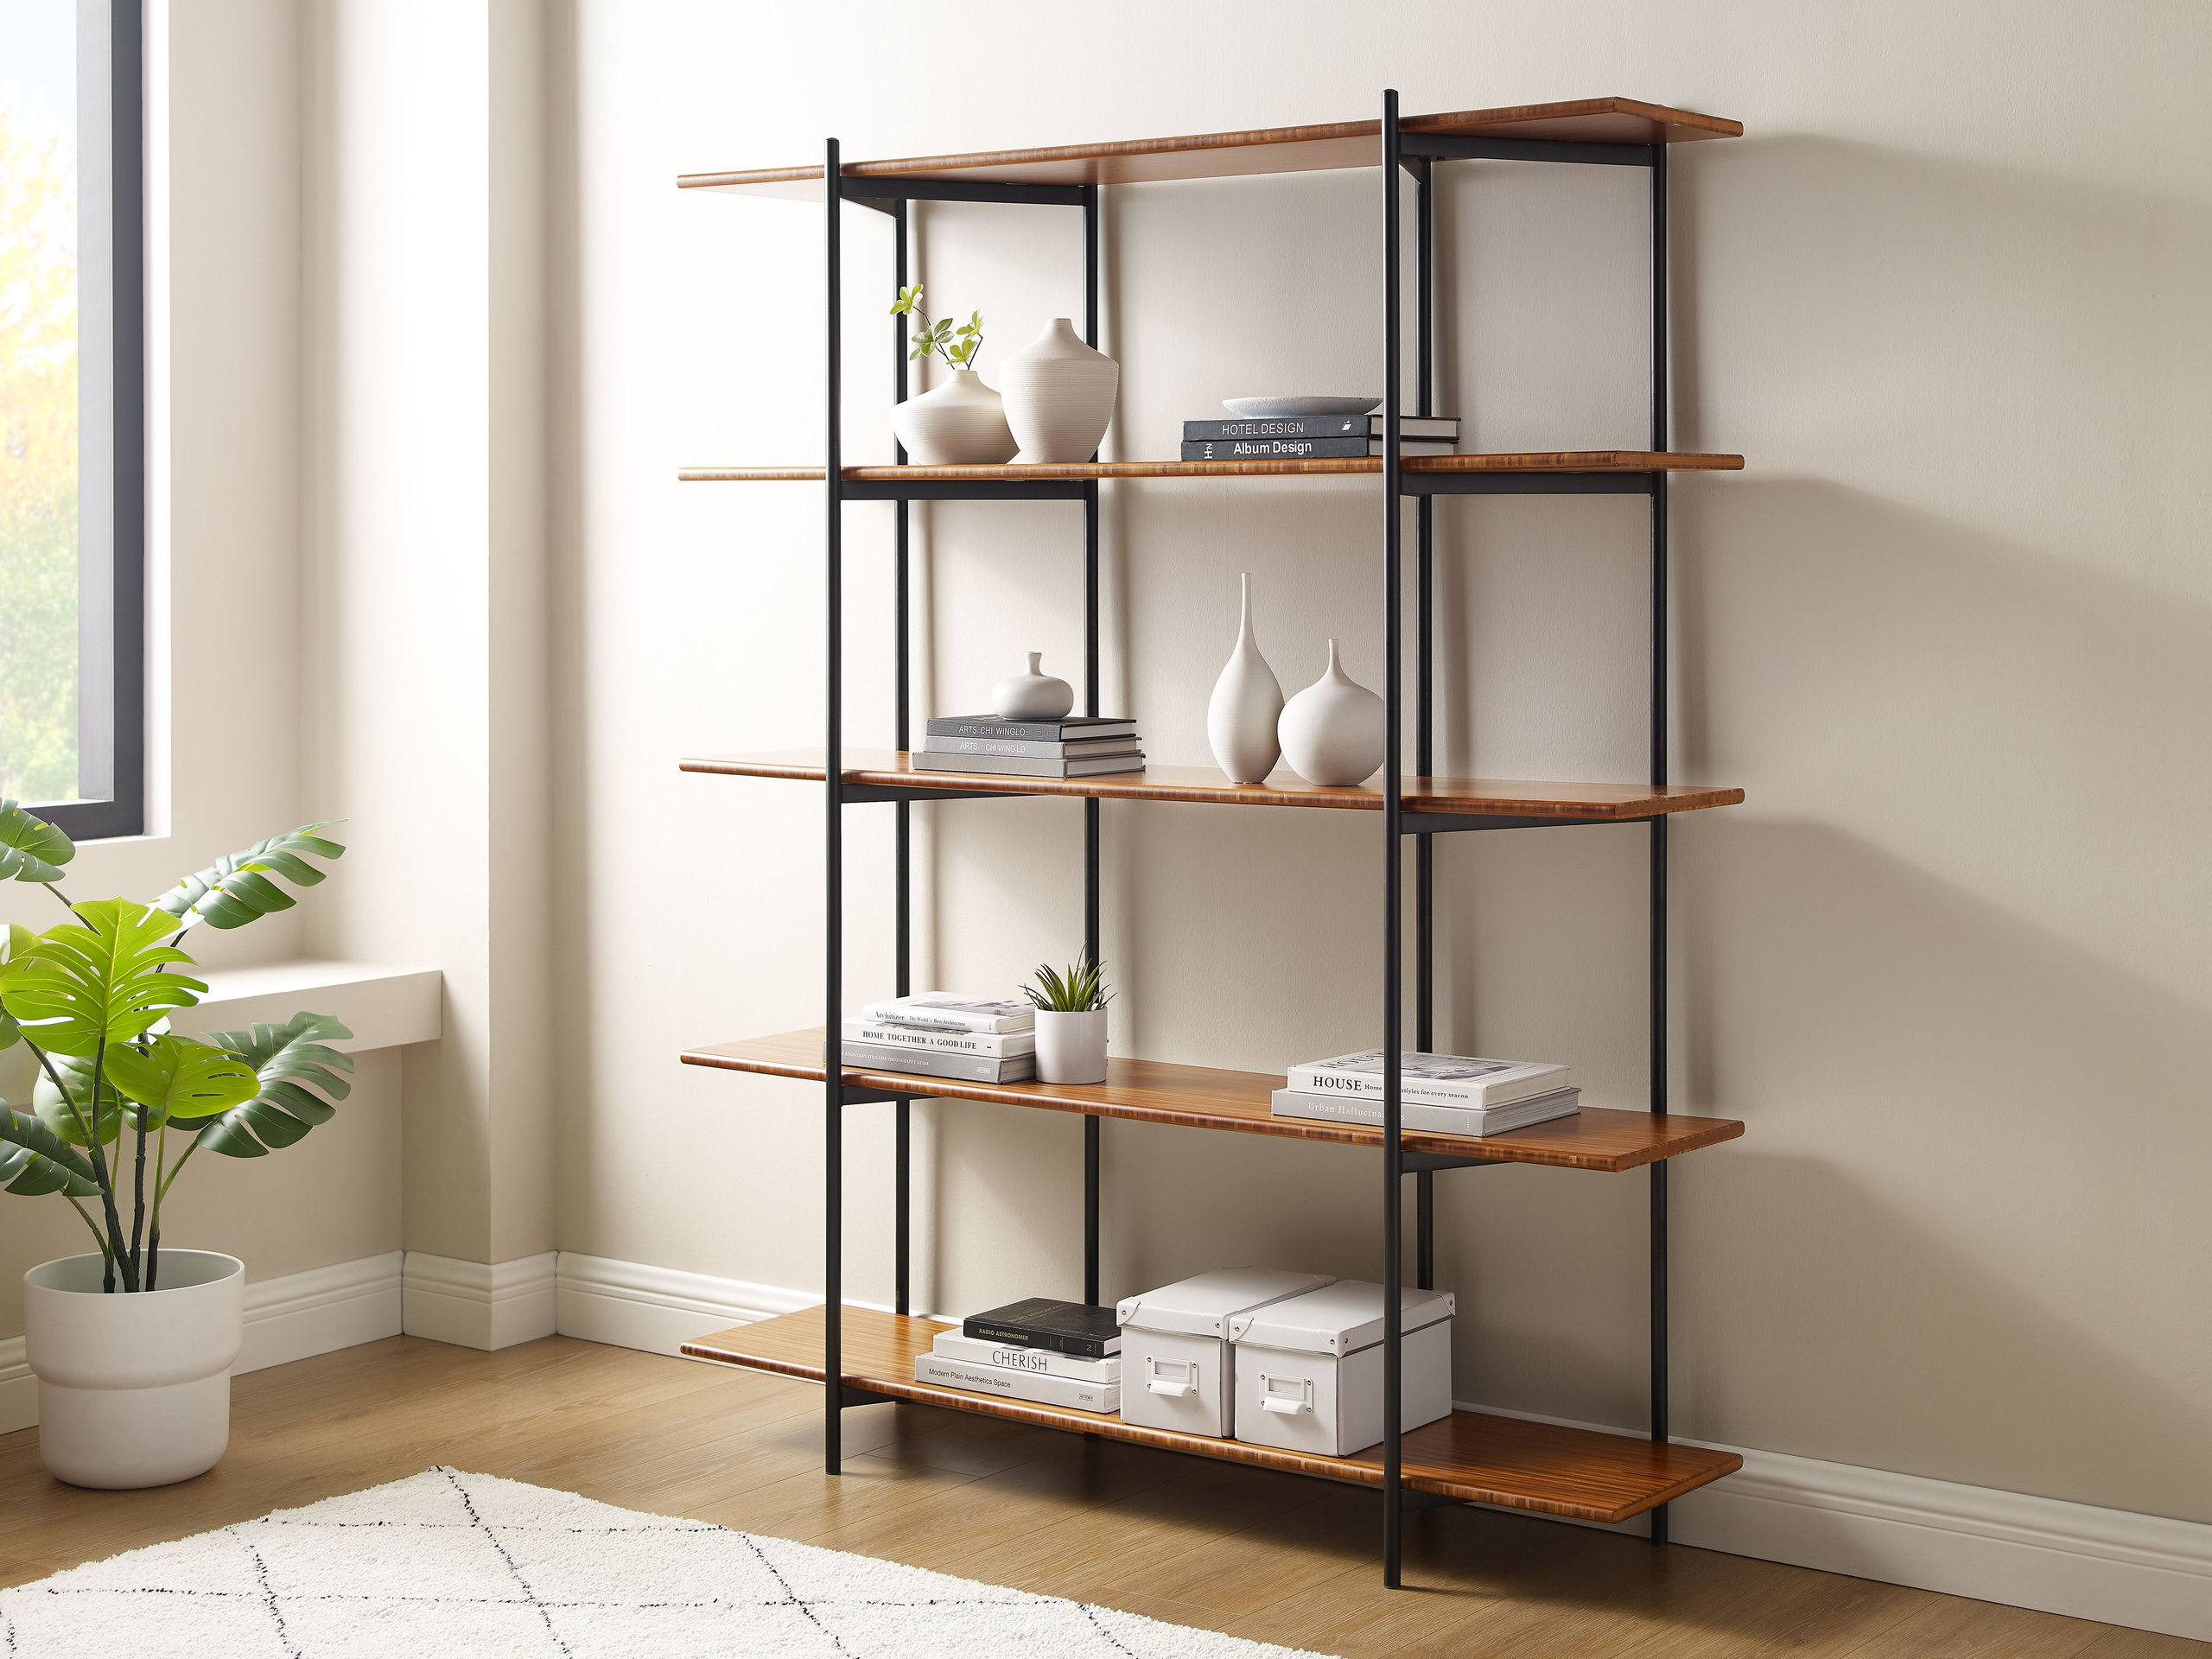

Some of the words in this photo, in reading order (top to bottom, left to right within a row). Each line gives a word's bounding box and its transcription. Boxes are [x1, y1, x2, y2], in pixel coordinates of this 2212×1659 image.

[1222, 423, 1259, 435] HOTEL
[1261, 423, 1304, 434] DESIGN
[1233, 442, 1270, 454] Album
[1272, 441, 1312, 455] Design
[980, 726, 993, 734] CHI
[862, 1031, 885, 1039] HOME
[887, 1033, 926, 1044] TOGETHER
[937, 1039, 959, 1047] GOOD
[960, 1041, 977, 1050] LIFE
[1313, 1076, 1362, 1090] HOUSE
[1308, 1103, 1335, 1113] Urban
[995, 1332, 1029, 1341] ASTRONOMER
[992, 1351, 1048, 1371] CHERISH
[929, 1368, 950, 1377] Modern
[964, 1375, 993, 1385] Aesthetics
[994, 1379, 1012, 1389] Space
